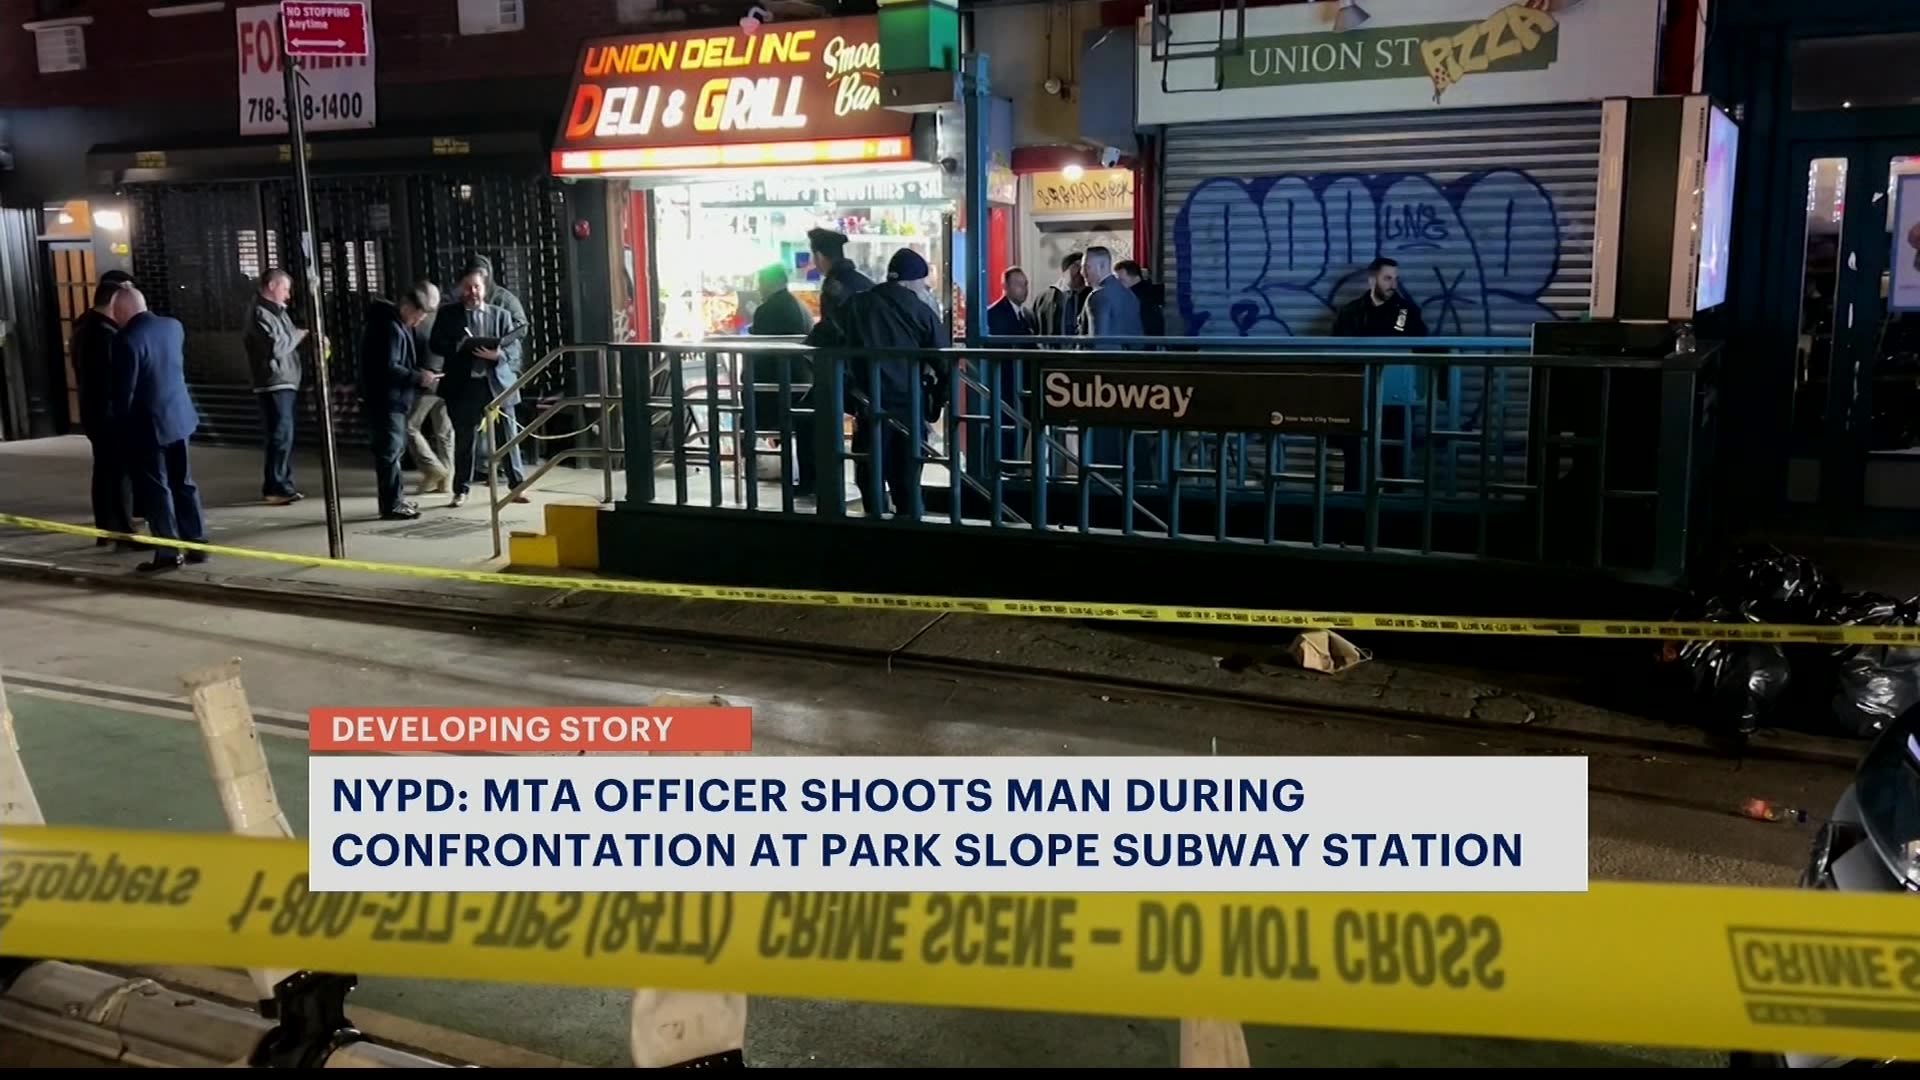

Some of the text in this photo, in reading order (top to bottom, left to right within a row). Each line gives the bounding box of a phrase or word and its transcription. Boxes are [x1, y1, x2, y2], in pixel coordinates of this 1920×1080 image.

[286, 7, 350, 18] NO STOPPING
[288, 19, 328, 31] Anytime
[239, 20, 284, 74] FO
[583, 30, 816, 76] UNION DELI INC
[823, 36, 880, 79] Smoo
[1250, 4, 1558, 94] UNION ST PIZZA
[248, 92, 362, 123] 718-38-1400
[565, 76, 808, 140] DELI & GRILL
[1045, 372, 1194, 418] Subway
